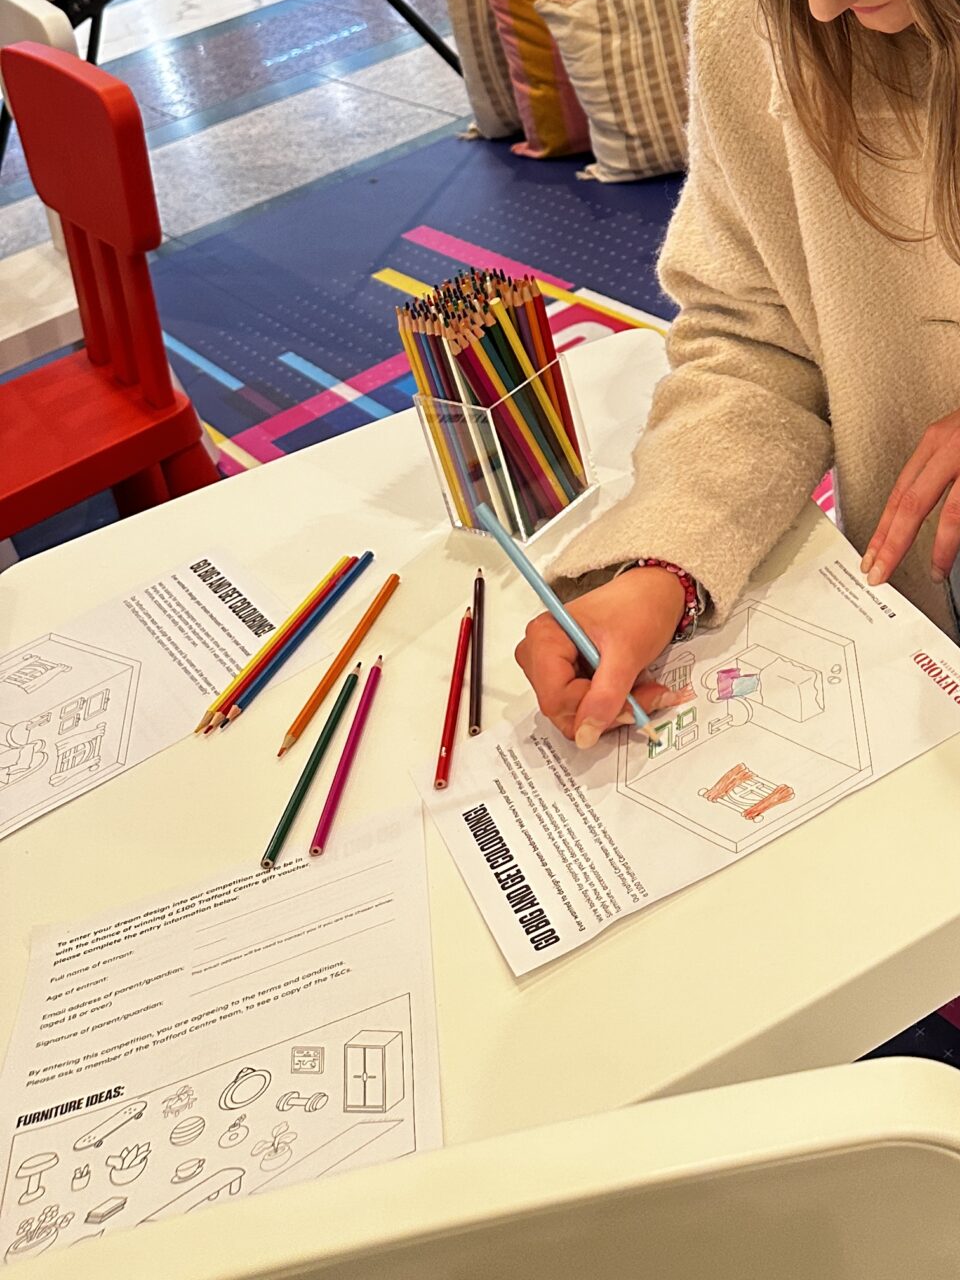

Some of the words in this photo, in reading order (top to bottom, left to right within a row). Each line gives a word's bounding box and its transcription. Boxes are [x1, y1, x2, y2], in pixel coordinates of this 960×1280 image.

[190, 559, 212, 573] GO
[197, 565, 221, 583] BIG
[206, 573, 232, 594] AND
[218, 585, 243, 604] GET
[228, 594, 276, 638] COLOURING!
[462, 803, 514, 870] COLOURING!
[494, 864, 526, 891] GET
[55, 947, 73, 956] with
[91, 930, 121, 944] chance
[123, 925, 132, 933] of
[134, 914, 166, 929] winning
[176, 902, 196, 914] £100
[198, 889, 231, 905] Trafford
[233, 881, 260, 893] Centre
[261, 874, 276, 884] gift
[69, 933, 91, 944] enter
[93, 926, 112, 936] your
[114, 916, 141, 928] dream
[143, 905, 170, 917] design
[172, 899, 188, 908] into
[190, 893, 204, 901] our
[206, 875, 253, 895] competition
[255, 867, 272, 877] and
[506, 884, 540, 914] AND
[53, 953, 81, 967] please
[83, 938, 122, 955] complete
[139, 924, 161, 935] entry
[164, 906, 211, 926] information
[213, 896, 238, 908] below:
[519, 908, 551, 936] BIG
[530, 928, 560, 951] GO
[50, 974, 65, 983] Full
[66, 966, 90, 978] name
[91, 961, 101, 969] of
[102, 951, 133, 965] entrant:
[42, 1008, 66, 1020] Email
[68, 997, 101, 1012] address
[114, 967, 184, 997] parent/guardian:
[46, 993, 63, 1002] Age
[76, 977, 107, 991] entrant:
[28, 1069, 41, 1077] By
[42, 1058, 81, 1073] entering
[83, 1052, 98, 1061] this
[100, 1033, 154, 1055] competition,
[156, 1026, 173, 1036] you
[174, 1019, 189, 1028] are
[191, 1004, 229, 1022] agreeing
[242, 994, 256, 1002] the
[258, 985, 281, 996] terms
[283, 976, 300, 987] and
[301, 961, 344, 980] conditions.
[35, 1032, 78, 1048] Signature
[80, 1026, 90, 1035] of
[91, 1002, 163, 1032] parent/guardian:
[39, 1017, 66, 1030] (aged
[68, 1013, 77, 1021] 18
[90, 1001, 112, 1013] over)
[26, 1075, 56, 1087] Please
[57, 1069, 73, 1078] ask
[84, 1054, 122, 1070] member
[124, 1048, 133, 1057] of
[135, 1044, 150, 1052] the
[152, 1029, 187, 1046] Trafford
[189, 1019, 217, 1032] Centre
[219, 1009, 243, 1021] team,
[257, 998, 271, 1007] see
[281, 986, 301, 998] copy
[303, 981, 312, 989] of
[314, 977, 328, 985] the
[16, 1097, 84, 1129] FURNITURE
[85, 1085, 125, 1108] IDEAS:
